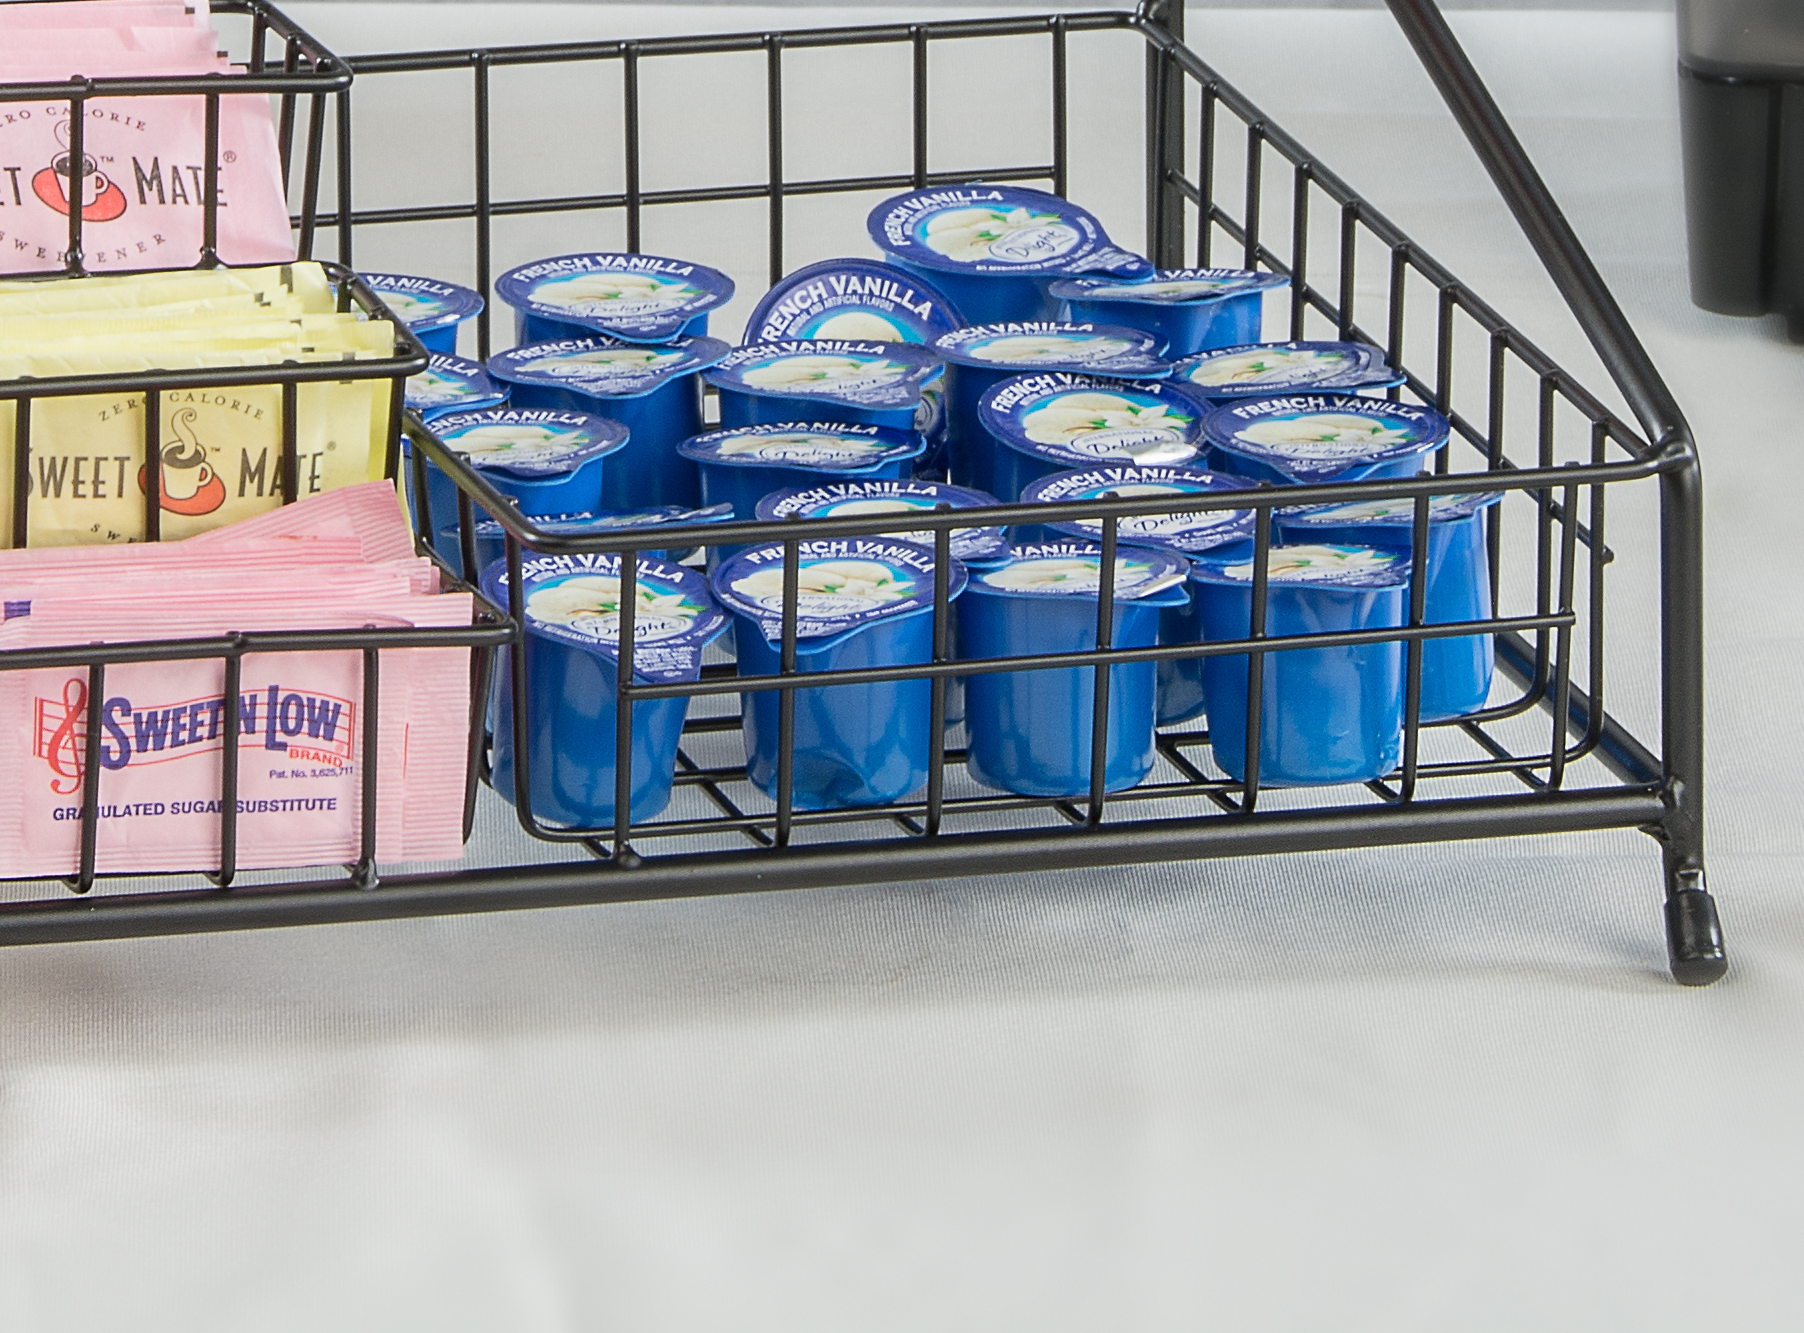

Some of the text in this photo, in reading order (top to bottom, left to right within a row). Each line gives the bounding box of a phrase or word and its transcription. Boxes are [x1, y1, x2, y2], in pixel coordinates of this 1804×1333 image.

[46, 106, 148, 132] CAORIE
[884, 190, 1004, 246] FRENCH VANILLA
[512, 256, 592, 283] FRENCH
[596, 255, 694, 276] VANILLA
[365, 275, 454, 296] VANILLA
[757, 274, 933, 343] RENCH VANILLA
[989, 320, 1094, 334] VANILLA
[507, 338, 595, 361] FRENCH
[781, 340, 886, 355] VANILLA
[168, 391, 266, 421] CALORIE
[991, 374, 1056, 414] FRENCH
[487, 410, 588, 426] VANILLA
[1232, 396, 1426, 421] FRENCH VANILLA
[1104, 466, 1213, 484] VANILLA
[830, 482, 937, 497] VANILLA
[856, 540, 936, 574] VANILLA
[264, 684, 342, 752] LOW
[289, 748, 343, 768] BRAND
[291, 769, 307, 779] No.
[53, 800, 165, 821] GRAULATED
[235, 797, 337, 814] SUBSTITUTE
